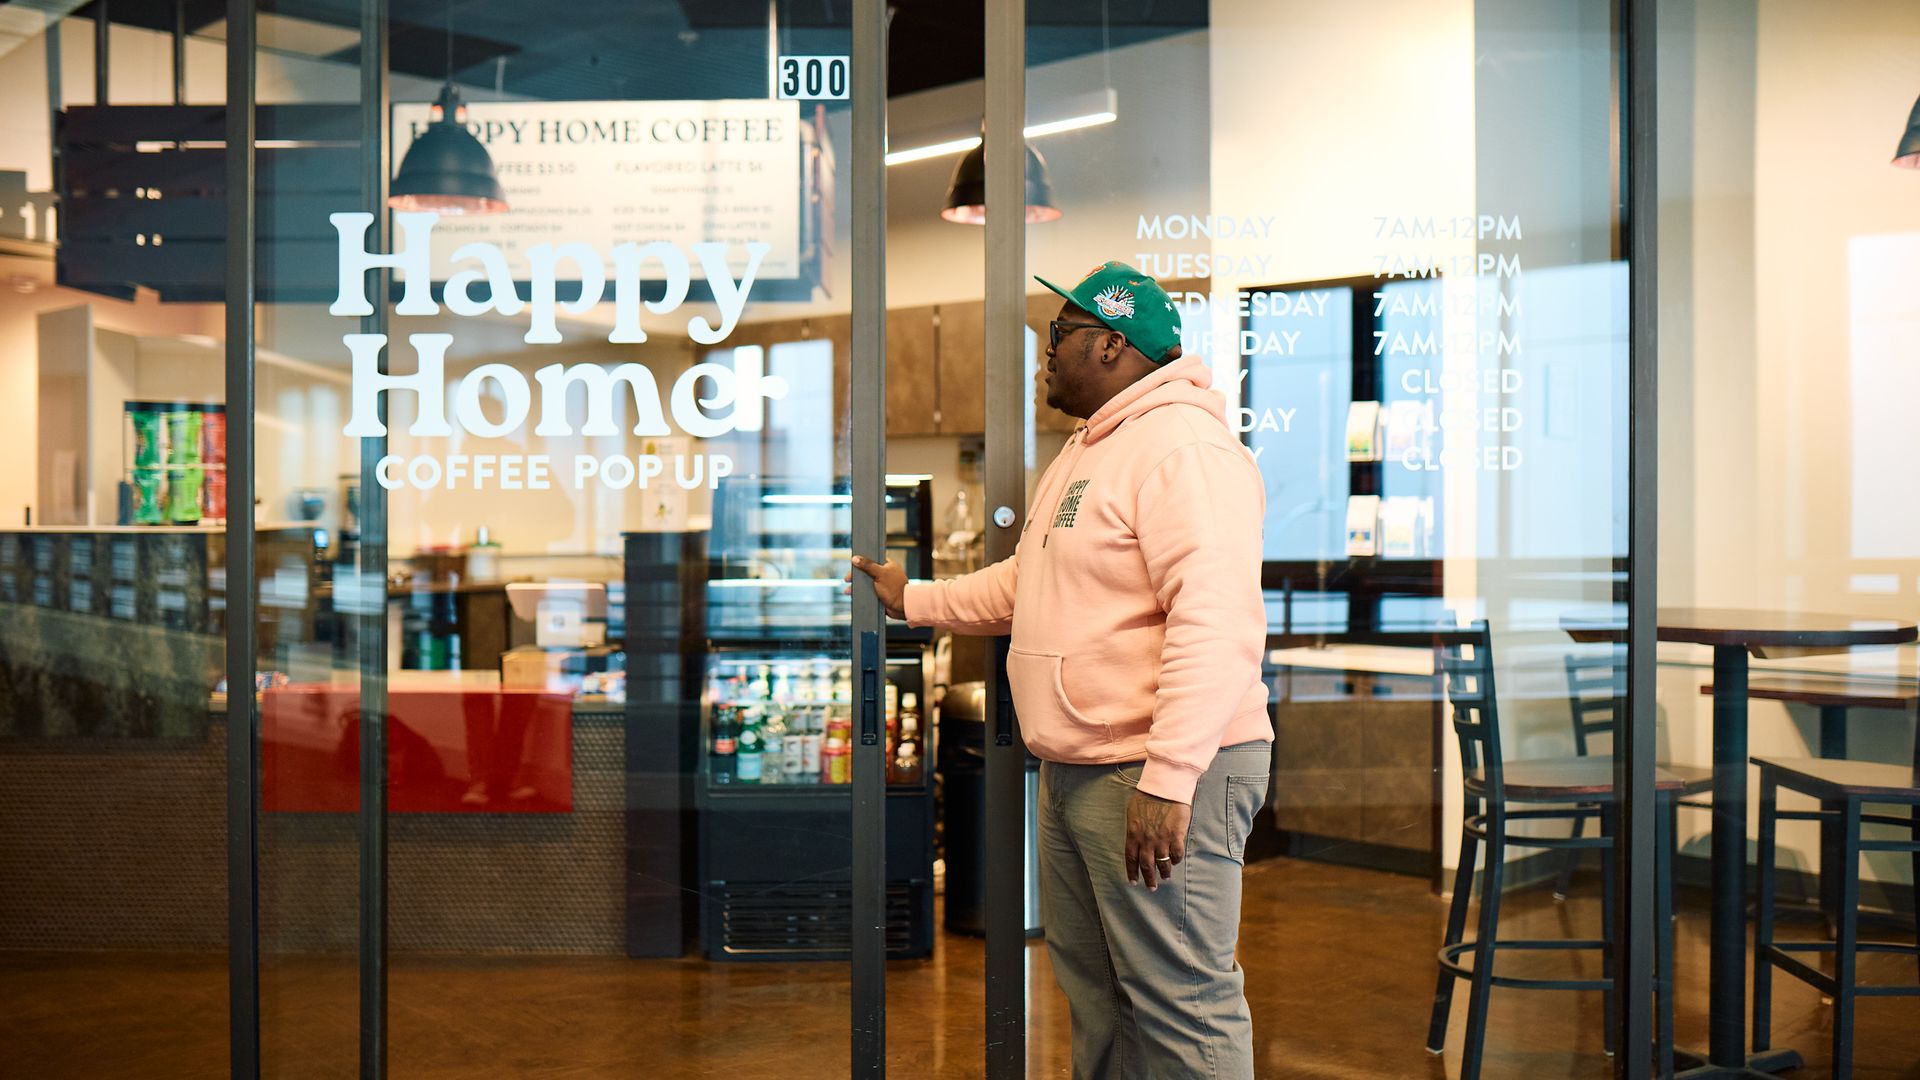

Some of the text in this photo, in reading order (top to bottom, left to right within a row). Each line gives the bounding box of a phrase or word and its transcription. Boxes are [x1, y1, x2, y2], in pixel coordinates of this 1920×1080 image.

[783, 58, 845, 96] 300
[538, 119, 642, 144] HOME
[651, 118, 784, 144] COFFEE
[1136, 214, 1522, 240] MONDAY 7AM-12PM
[329, 212, 771, 345] Happy
[1135, 253, 1522, 279] TUESDAY 7AM-12PM
[1164, 291, 1331, 318] EDNESDAY
[1373, 292, 1522, 318] 7AM-12PM
[1182, 330, 1522, 356] URSDAY 7AM-12PM
[343, 333, 789, 438] Home
[1401, 369, 1523, 394] CLOSED
[1401, 446, 1523, 472] CLOSED
[375, 455, 734, 490] COFFEE POP UP
